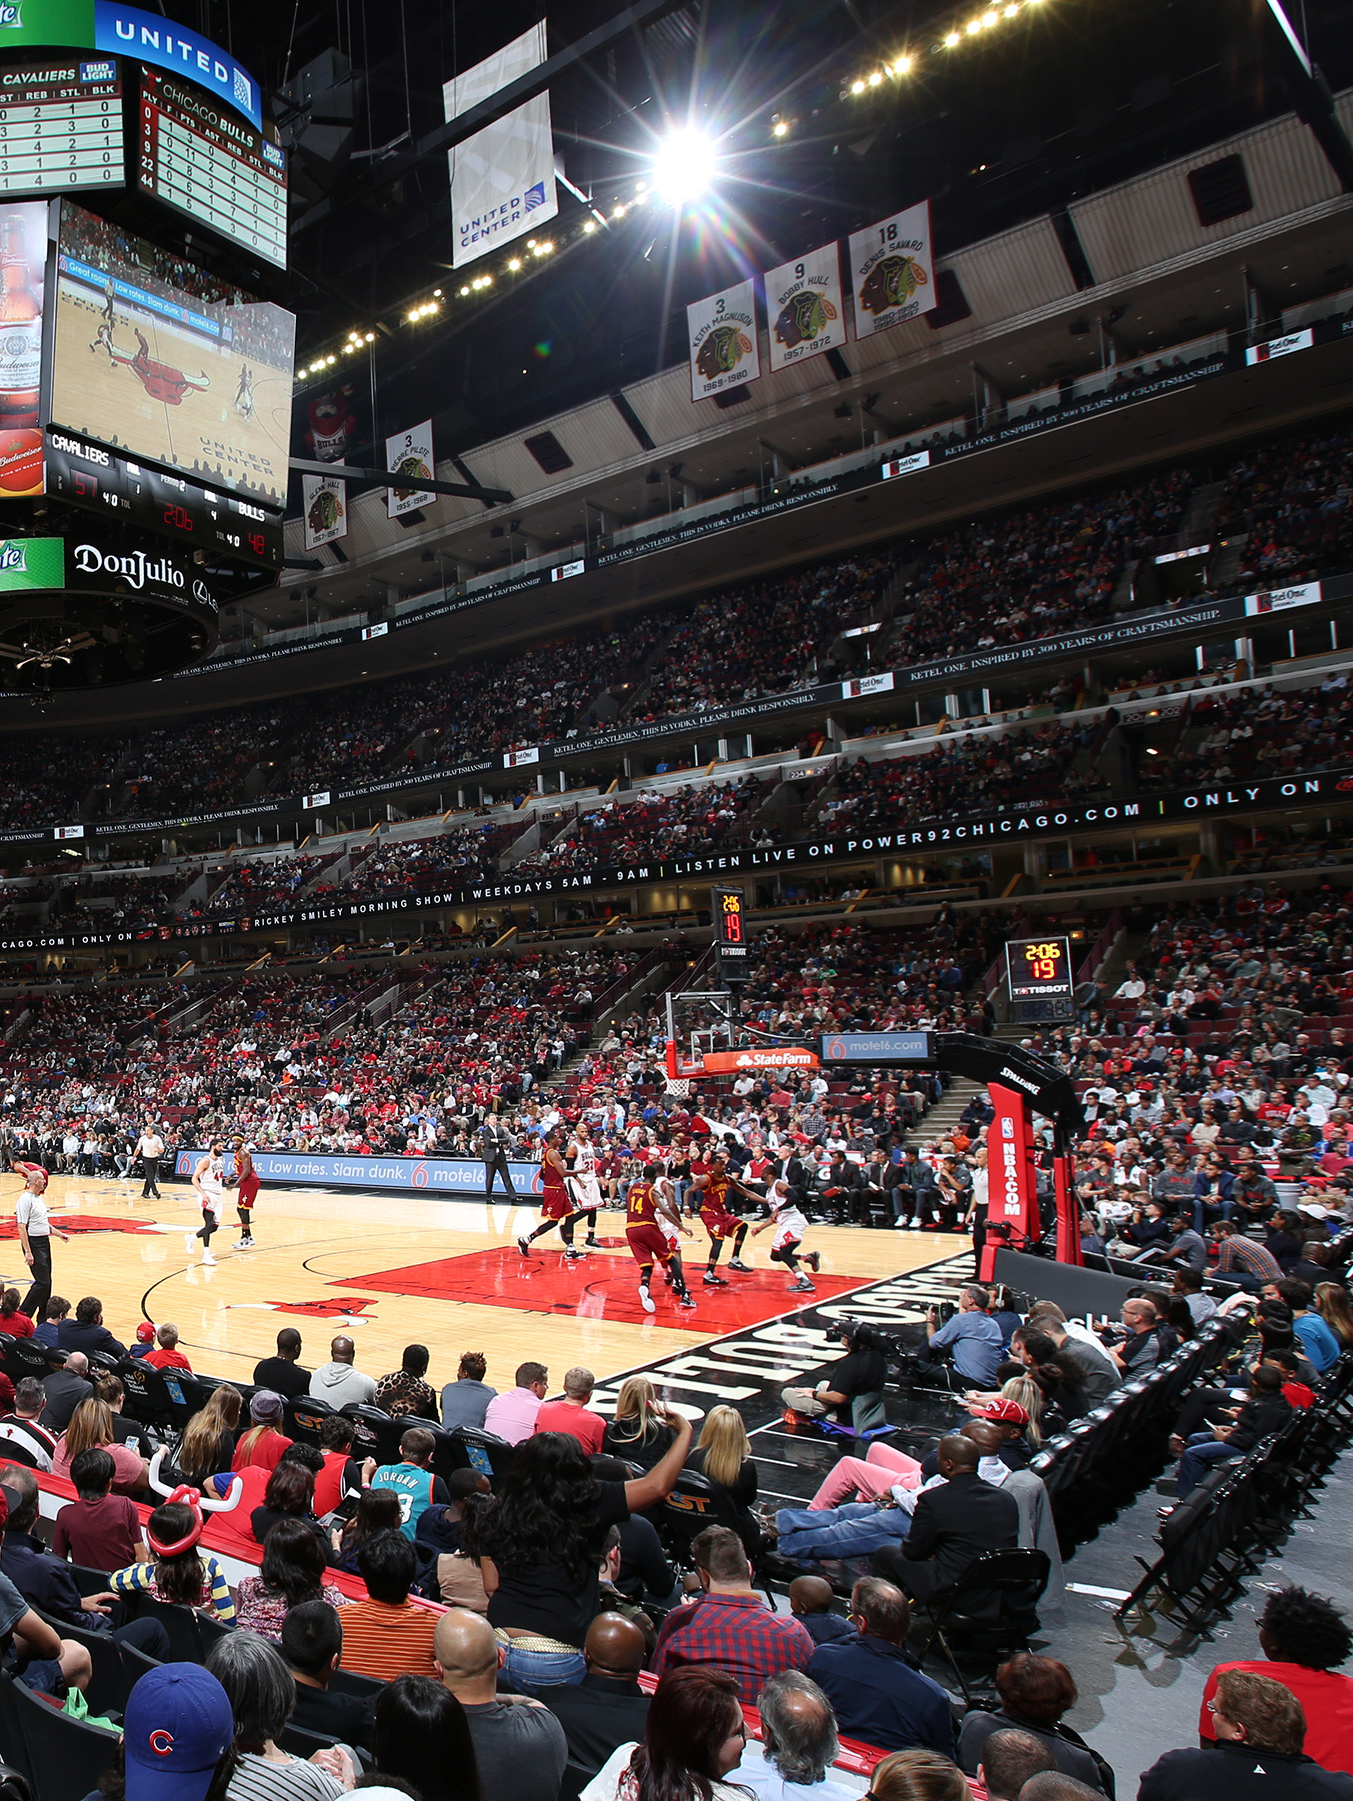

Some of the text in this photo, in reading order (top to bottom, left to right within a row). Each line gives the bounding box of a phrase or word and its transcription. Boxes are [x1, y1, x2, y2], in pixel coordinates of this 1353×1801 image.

[116, 20, 228, 83] UNITED
[3, 70, 75, 85] CAVALIERS
[82, 71, 114, 80] LIGHT
[87, 63, 109, 72] BUD
[92, 85, 114, 94] BLK
[163, 84, 253, 147] CHICAGO BULLS
[460, 198, 520, 234] UNITED
[462, 211, 520, 247] CENTER
[879, 224, 897, 244] 18
[859, 240, 923, 275] DENIS SAVARD
[795, 263, 805, 279] 9
[779, 275, 828, 304] BOBBY HULL
[716, 299, 725, 314] 3
[693, 312, 753, 347] KEITH MAGNUSON
[784, 336, 831, 360] 1957-1972
[703, 370, 748, 391] 1969-1980
[52, 434, 109, 467] CAVALIERS
[199, 436, 271, 465] UNITED
[317, 437, 343, 449] BULLS
[405, 435, 412, 447] 3
[203, 448, 275, 476] CENTER
[391, 447, 429, 471] PIERRE PILOTE
[75, 473, 265, 554] 57 2:06 BULLS 48
[910, 667, 942, 680] KETEL
[971, 651, 1018, 668] INSPIRED
[1022, 649, 1035, 659] BY
[1037, 644, 1057, 656] 300
[1059, 635, 1095, 650] YEARS
[1098, 631, 1114, 642] OF
[554, 743, 575, 754] KETEL
[642, 725, 659, 735] THIS
[661, 723, 668, 732] IS
[699, 712, 729, 723] PLEASE
[731, 705, 757, 718] DRINK
[1185, 780, 1319, 808] ONLY ON
[675, 843, 834, 873] LISTEN LIVE ON
[473, 880, 552, 900] WEEKDAYS
[254, 893, 453, 927] RICKEY SMILEY MORNING SHOW
[1026, 943, 1060, 960] 2:06
[1033, 960, 1054, 979] 19
[1034, 984, 1068, 994] TISSOT
[850, 1039, 923, 1051] motel6.com
[1000, 1067, 1041, 1095] SPALDING
[269, 1160, 407, 1180] Low rates. Slam dunk.
[1004, 1143, 1021, 1215] NBA.COM
[630, 1196, 643, 1214] 14
[379, 1471, 417, 1489] JORDAN
[149, 1729, 175, 1756] C
